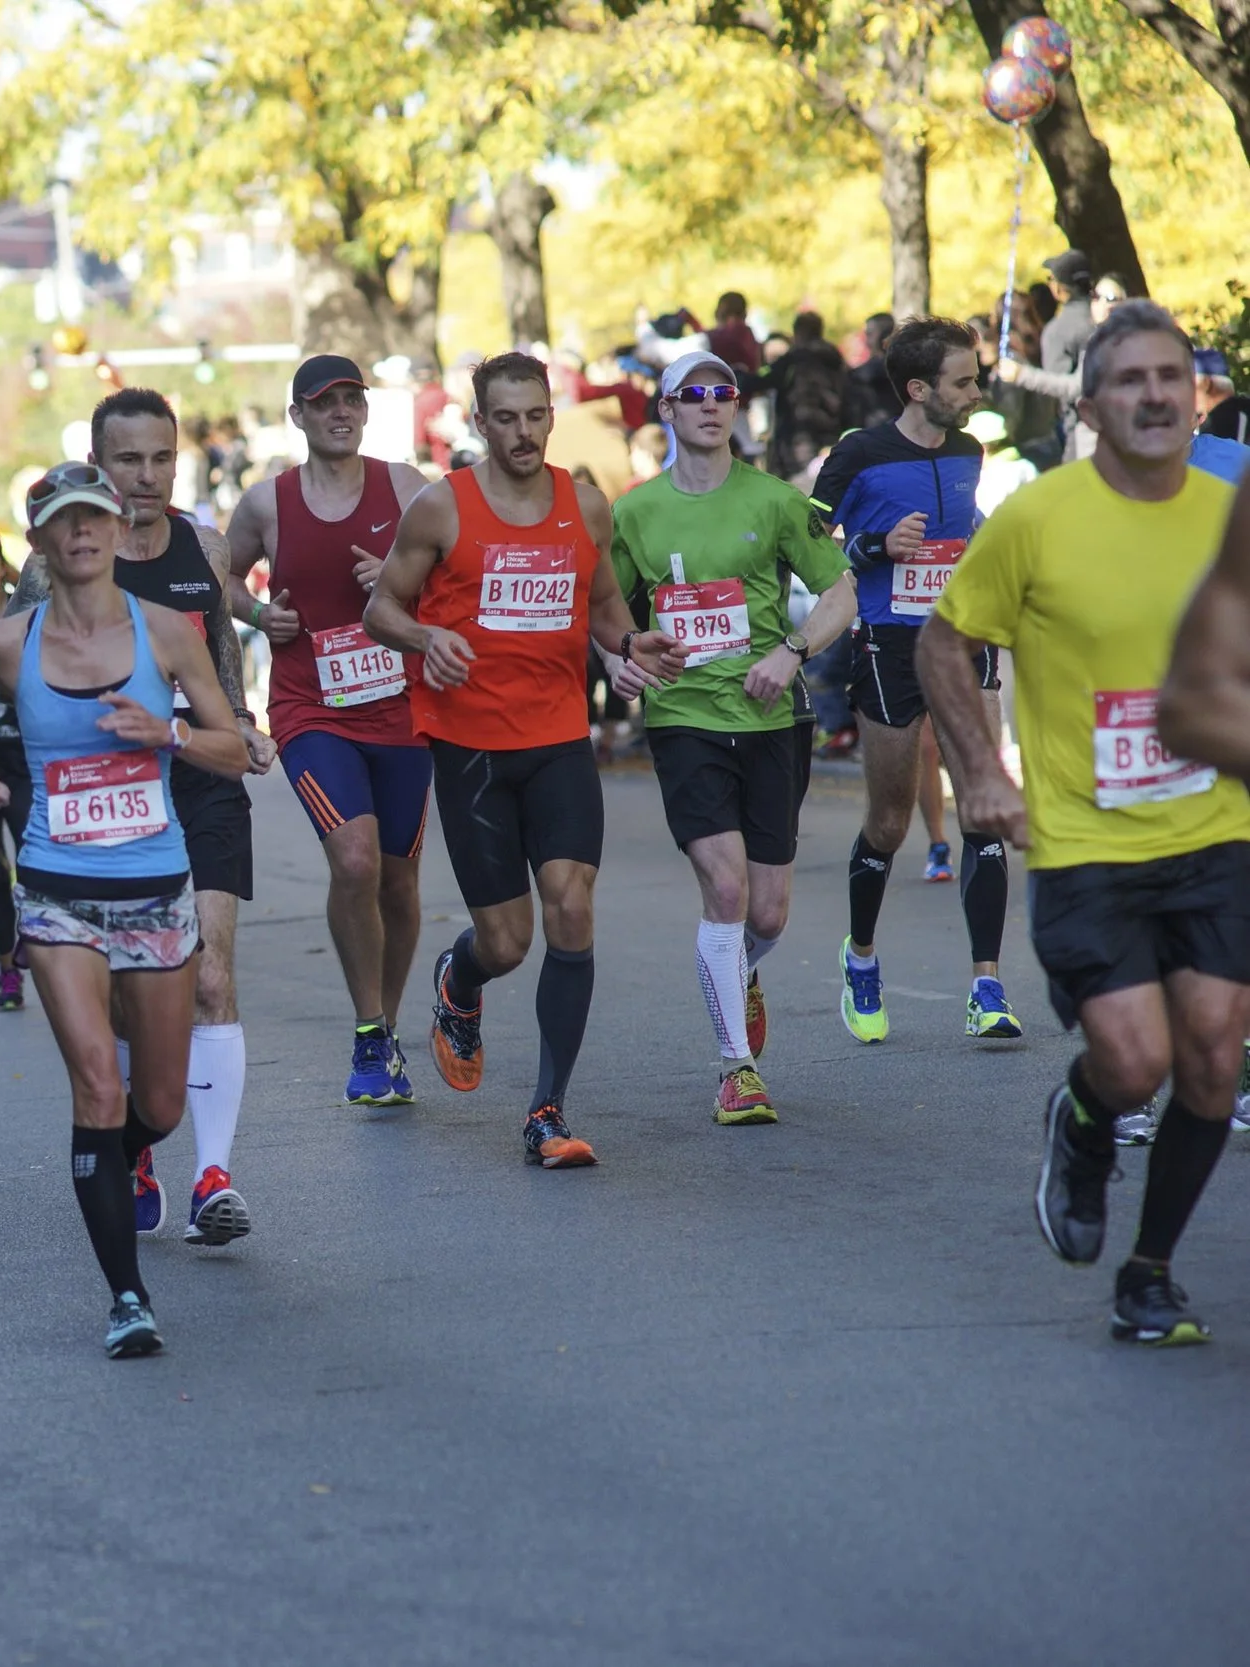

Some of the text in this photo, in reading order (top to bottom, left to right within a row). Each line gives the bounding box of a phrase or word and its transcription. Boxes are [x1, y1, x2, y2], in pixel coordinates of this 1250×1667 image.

[488, 580, 570, 603] B 10242
[904, 569, 952, 591] B 449
[673, 613, 731, 640] B 879
[700, 643, 724, 651] October
[330, 649, 393, 682] B 1416
[362, 680, 384, 689] October
[1115, 737, 1132, 770] B
[64, 789, 149, 825] B 6135
